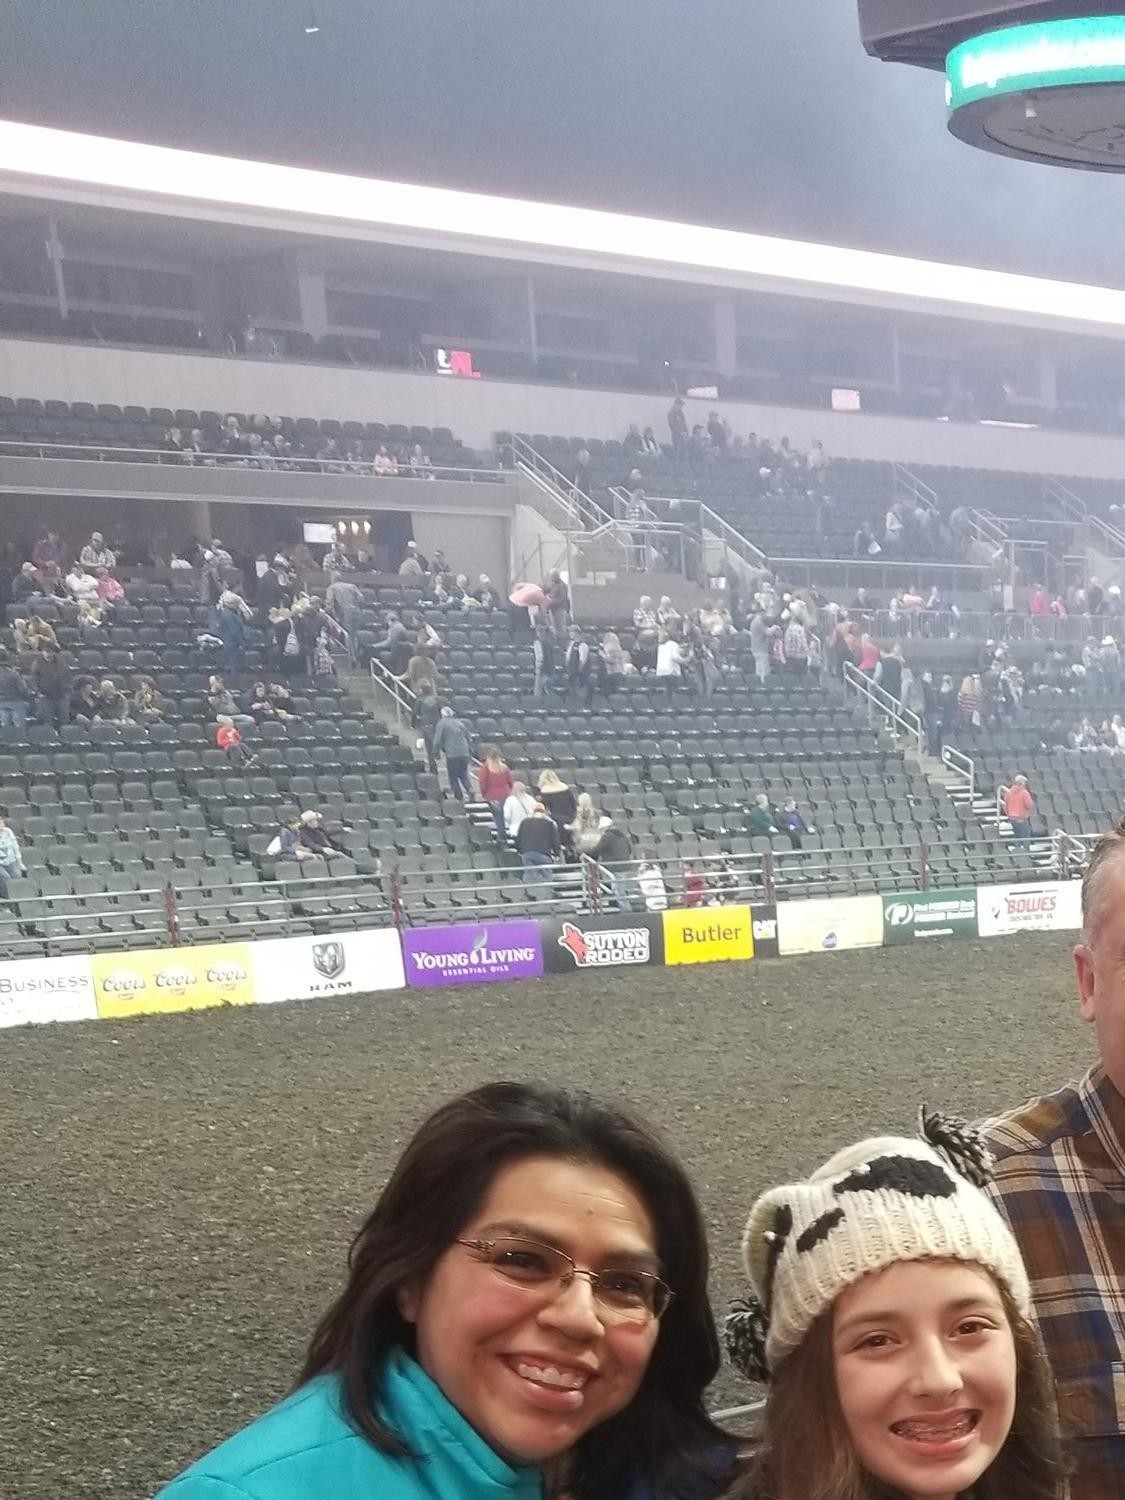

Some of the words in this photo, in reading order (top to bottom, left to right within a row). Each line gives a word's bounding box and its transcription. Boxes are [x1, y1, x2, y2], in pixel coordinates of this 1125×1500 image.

[682, 925, 742, 943] Butler
[753, 920, 778, 940] CAT
[585, 929, 650, 950] SUTTON
[411, 951, 469, 971] YOUNG
[479, 946, 537, 965] LIVING
[585, 948, 649, 964] RODEO
[152, 971, 198, 988] Coors
[204, 966, 250, 983] Coors
[101, 976, 147, 993] Coors
[308, 981, 353, 992] RAM
